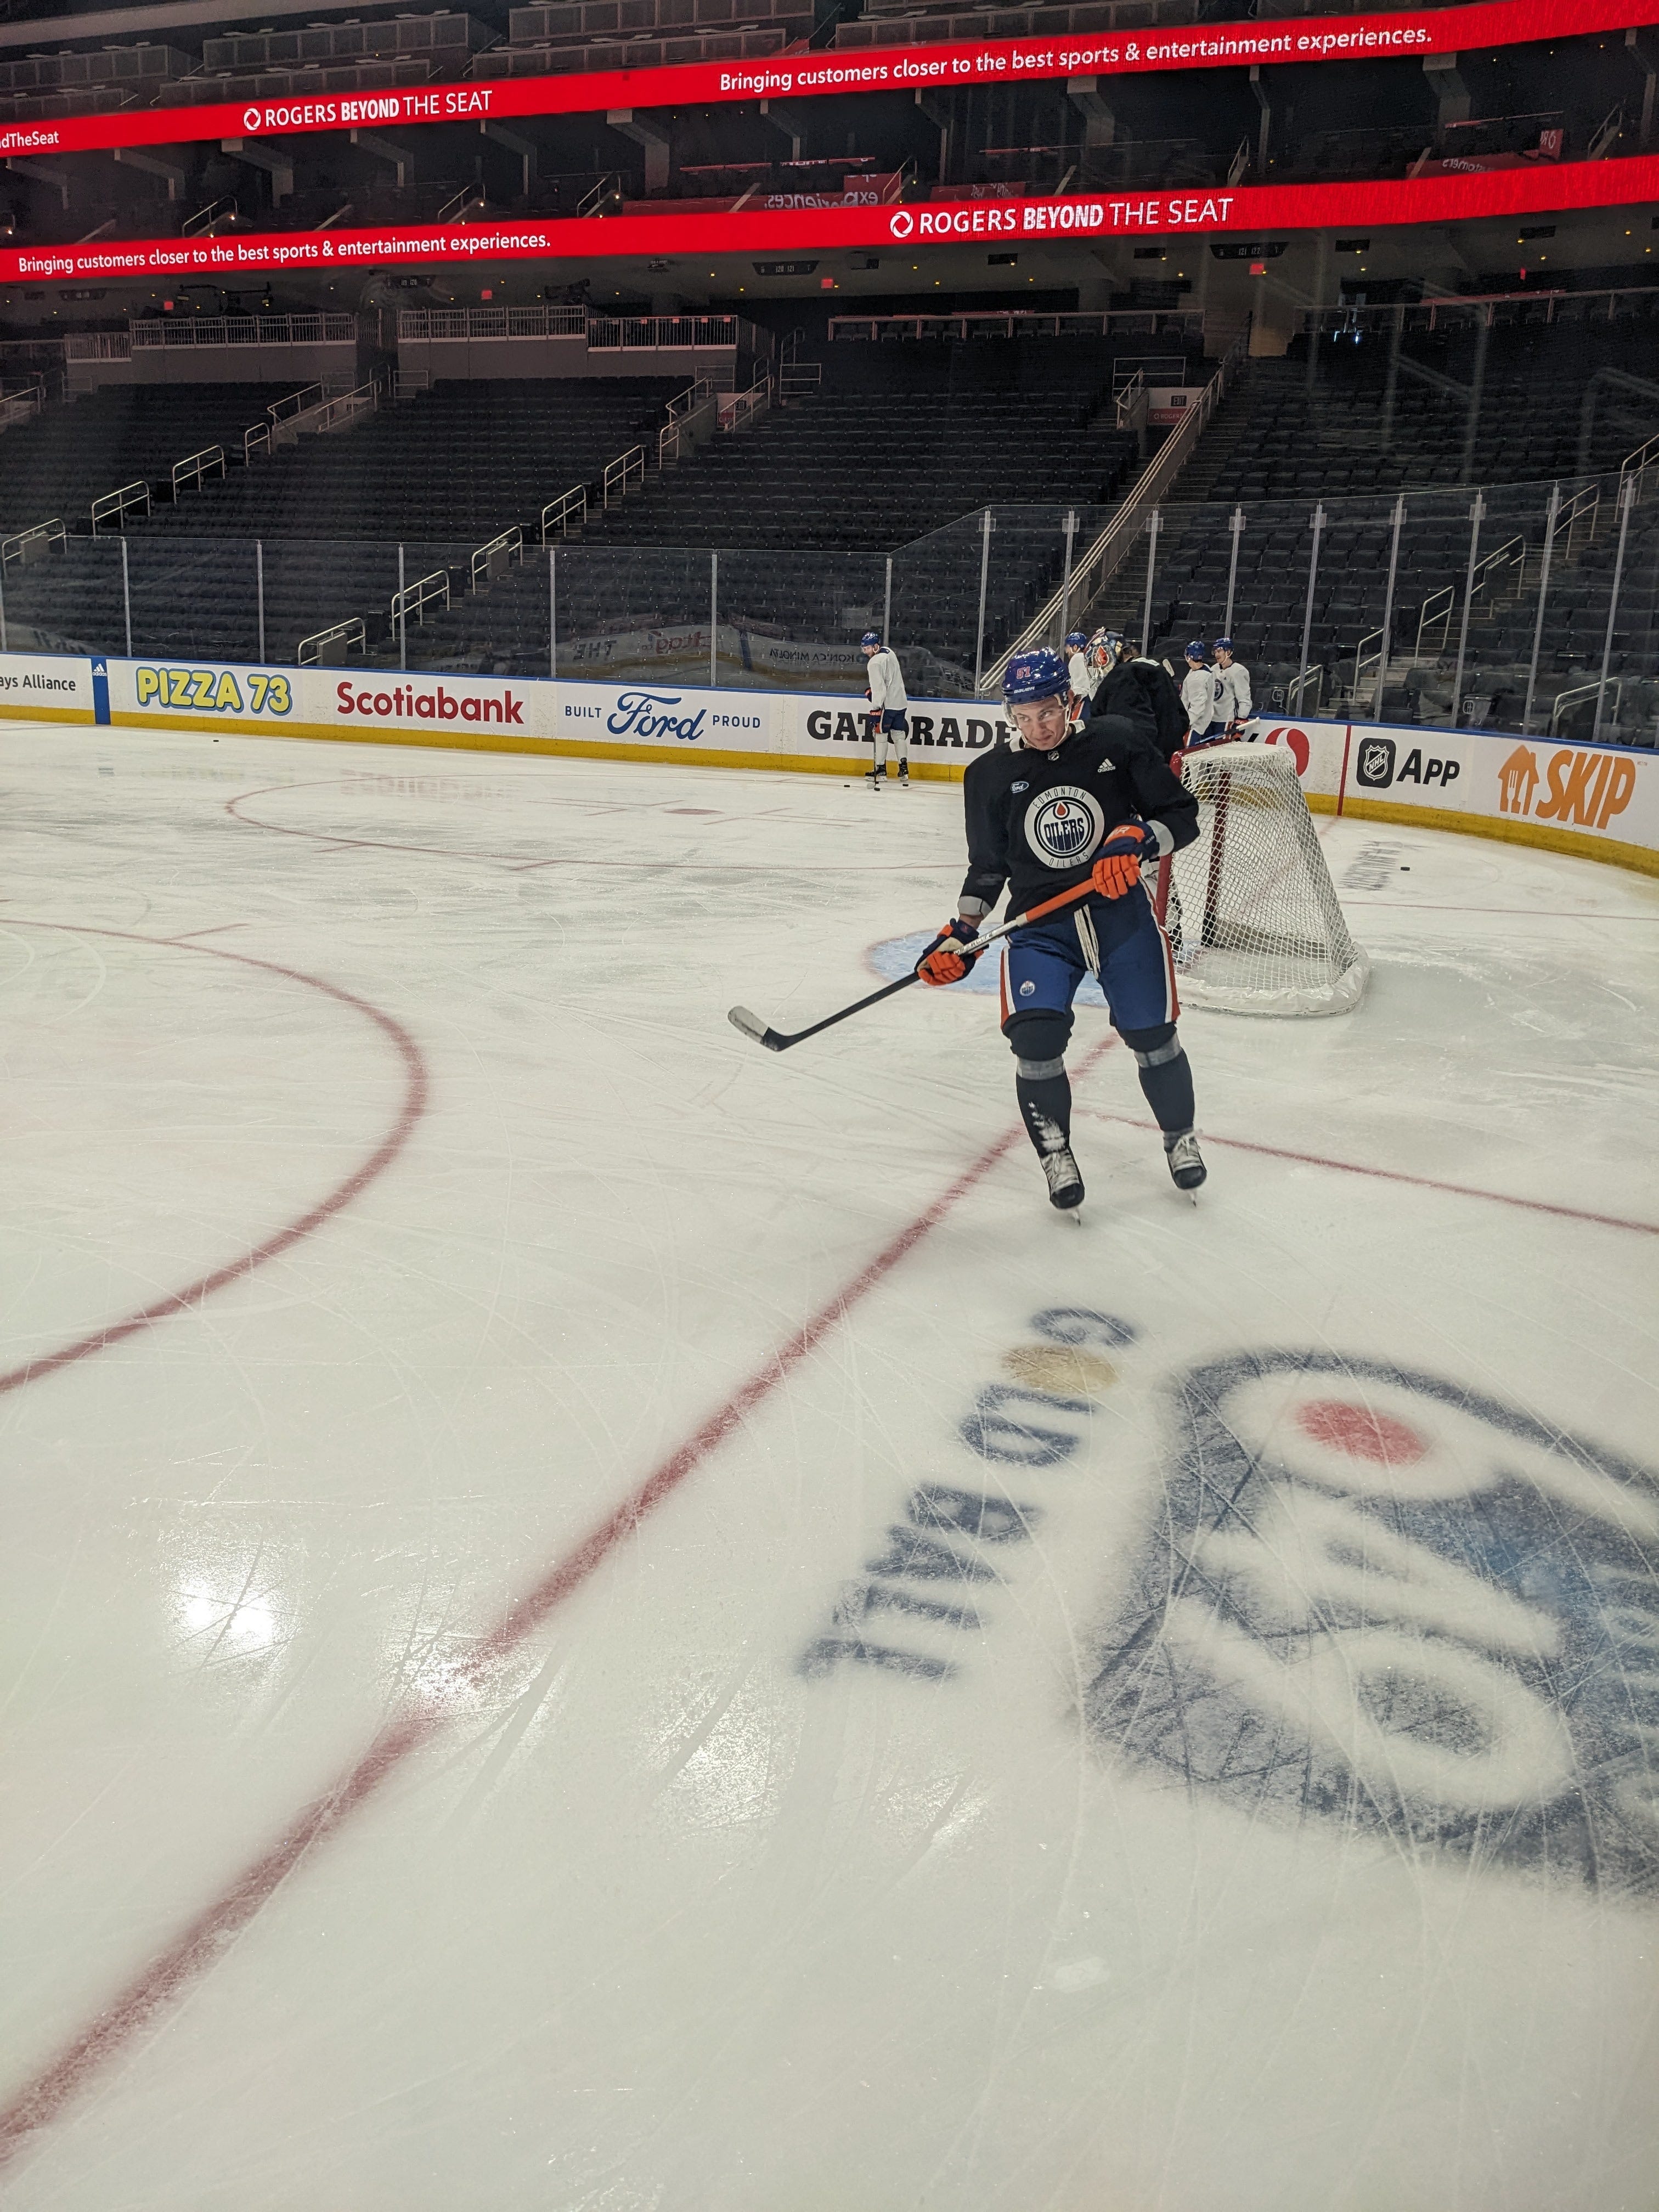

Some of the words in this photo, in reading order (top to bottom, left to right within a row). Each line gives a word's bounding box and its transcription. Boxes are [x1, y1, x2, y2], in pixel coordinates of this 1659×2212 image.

[721, 70, 792, 92] Bringing
[798, 67, 887, 84] customers
[894, 59, 947, 77] closer
[952, 59, 970, 72] to
[976, 53, 1006, 71] the
[1013, 50, 1053, 69] best
[1059, 47, 1119, 70] sports
[1126, 43, 1139, 60] &
[1147, 35, 1291, 59] entertainment
[1297, 27, 1432, 53] experiences.
[266, 104, 336, 126] ROGERS
[341, 99, 399, 121] BEYOND
[403, 95, 440, 116] THE
[446, 91, 493, 113] SEAT
[921, 209, 1015, 234] ROGERS
[1024, 205, 1104, 230] BEYOND
[1109, 202, 1159, 225] THE
[1168, 198, 1233, 223] SEAT
[19, 256, 73, 274] Bringing
[77, 255, 145, 269] customers
[149, 249, 189, 264] closer
[193, 250, 207, 263] to
[211, 246, 234, 261] the
[238, 245, 269, 260] best
[273, 244, 318, 263] sports
[323, 241, 334, 256] &
[338, 237, 446, 256] entertainment
[451, 233, 550, 255] experiences.
[22, 675, 76, 692] Alliance
[1016, 666, 1031, 679] 51
[136, 667, 244, 713] PIZZA
[247, 674, 292, 716] 73
[337, 681, 524, 724] Scotiabank
[565, 706, 601, 718] BUILT
[607, 692, 707, 740] Ford
[712, 714, 760, 728] PROUD
[806, 710, 1017, 748] GATRADE
[1368, 754, 1384, 772] NHL
[1032, 787, 1086, 809] EDMONTON
[1535, 749, 1636, 830] SKIP
[1043, 817, 1085, 851] OILERS
[1048, 852, 1089, 867] OILERS
[797, 1480, 1042, 1682] BALL
